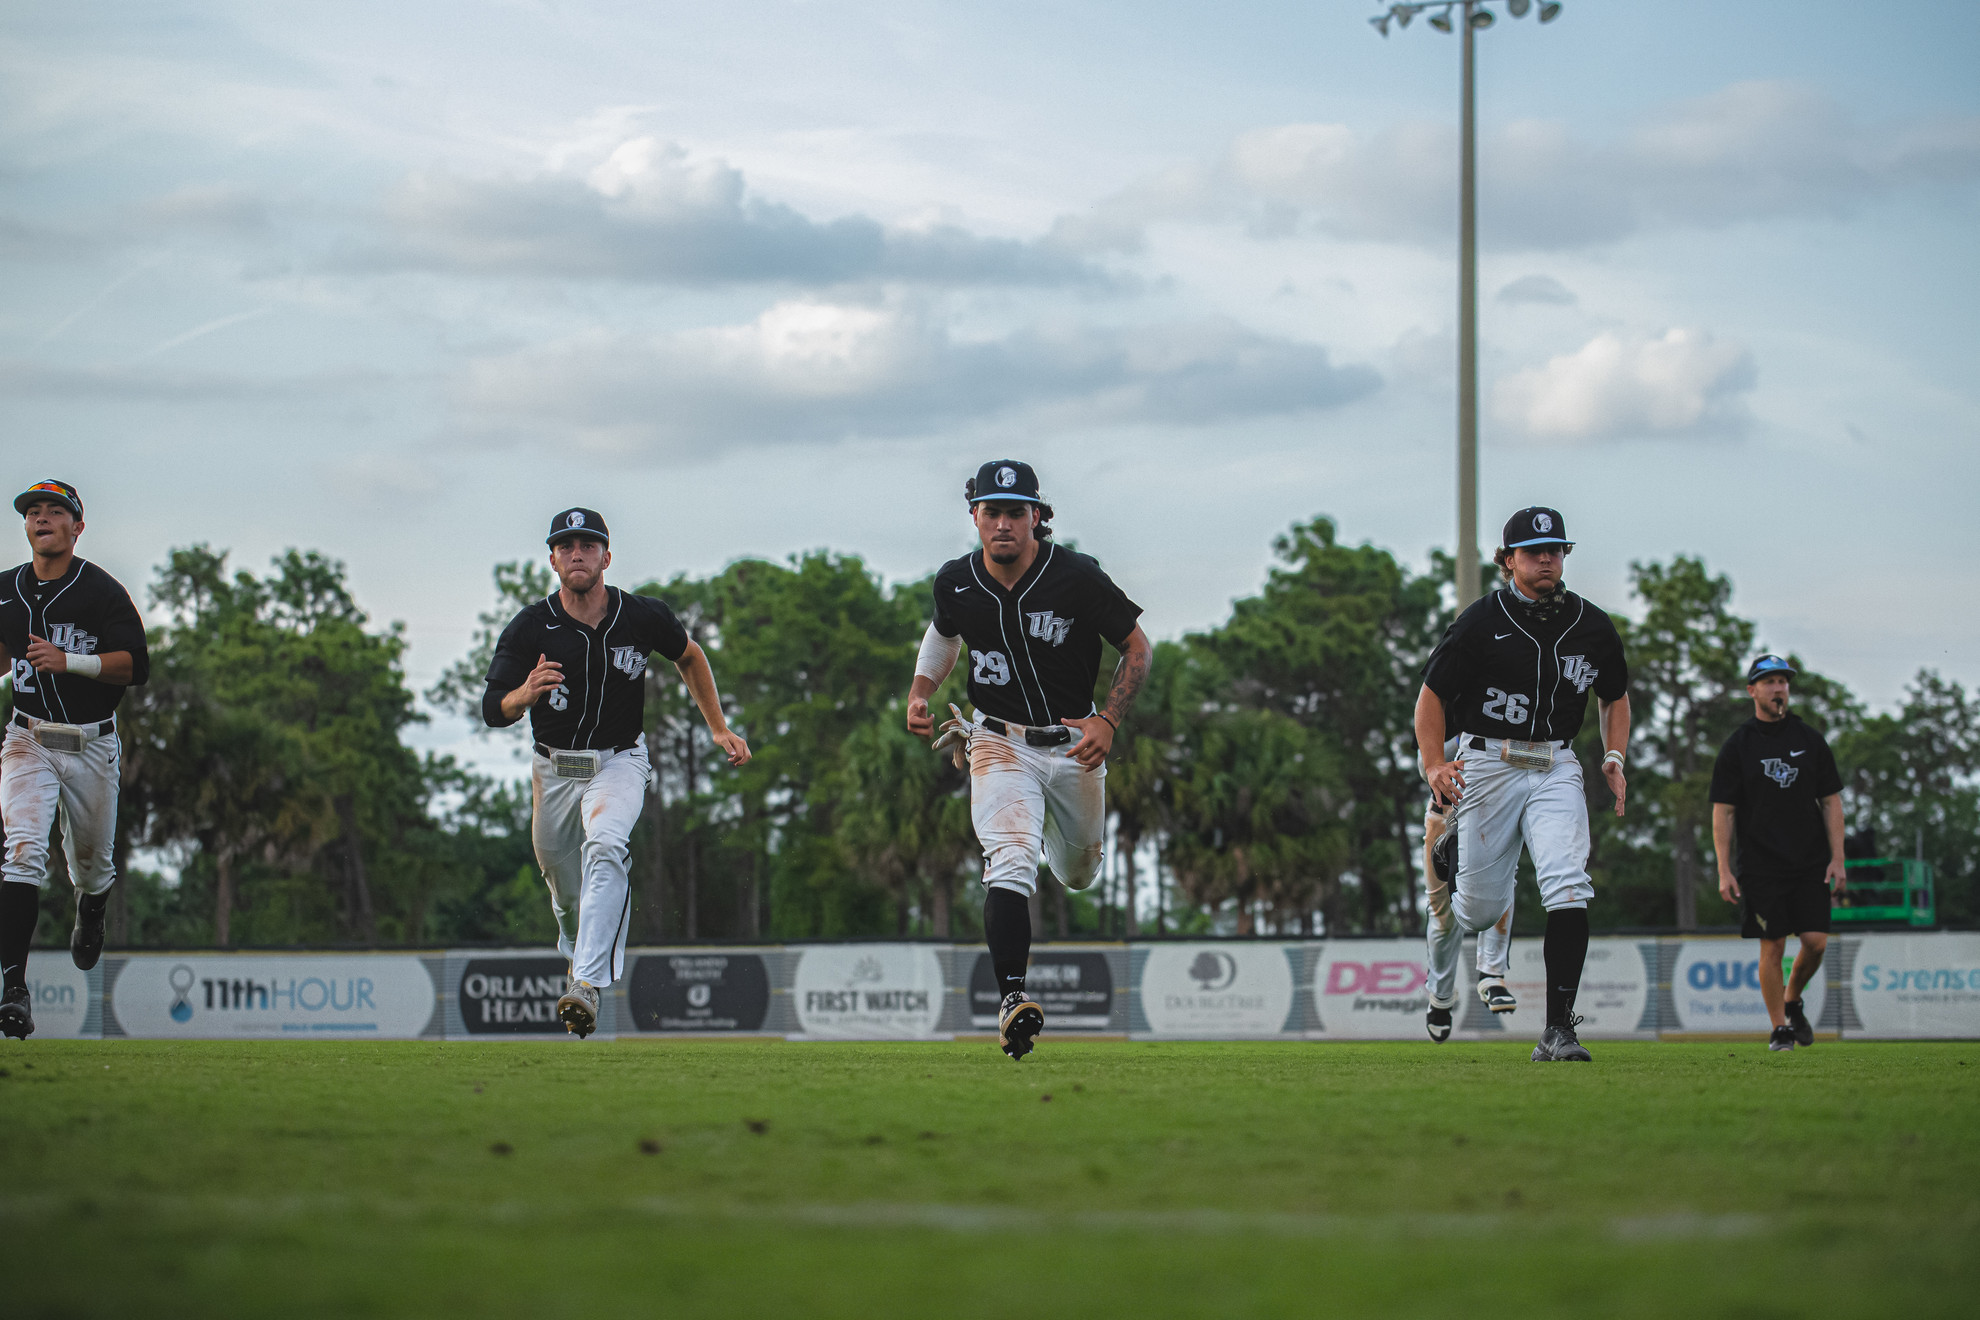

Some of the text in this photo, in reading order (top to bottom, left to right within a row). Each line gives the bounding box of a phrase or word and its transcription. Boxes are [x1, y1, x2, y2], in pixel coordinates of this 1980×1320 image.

[49, 623, 97, 655] UCF
[1025, 610, 1074, 647] UCF
[610, 645, 648, 681] UCF
[970, 649, 1011, 686] 29
[1560, 654, 1599, 694] UCF
[548, 683, 570, 711] 6
[1482, 686, 1530, 725] 26
[1760, 757, 1798, 788] UCF
[465, 973, 567, 999] ORLAND
[806, 991, 929, 1012] FIRST WATCH
[481, 999, 558, 1023] HEALT
